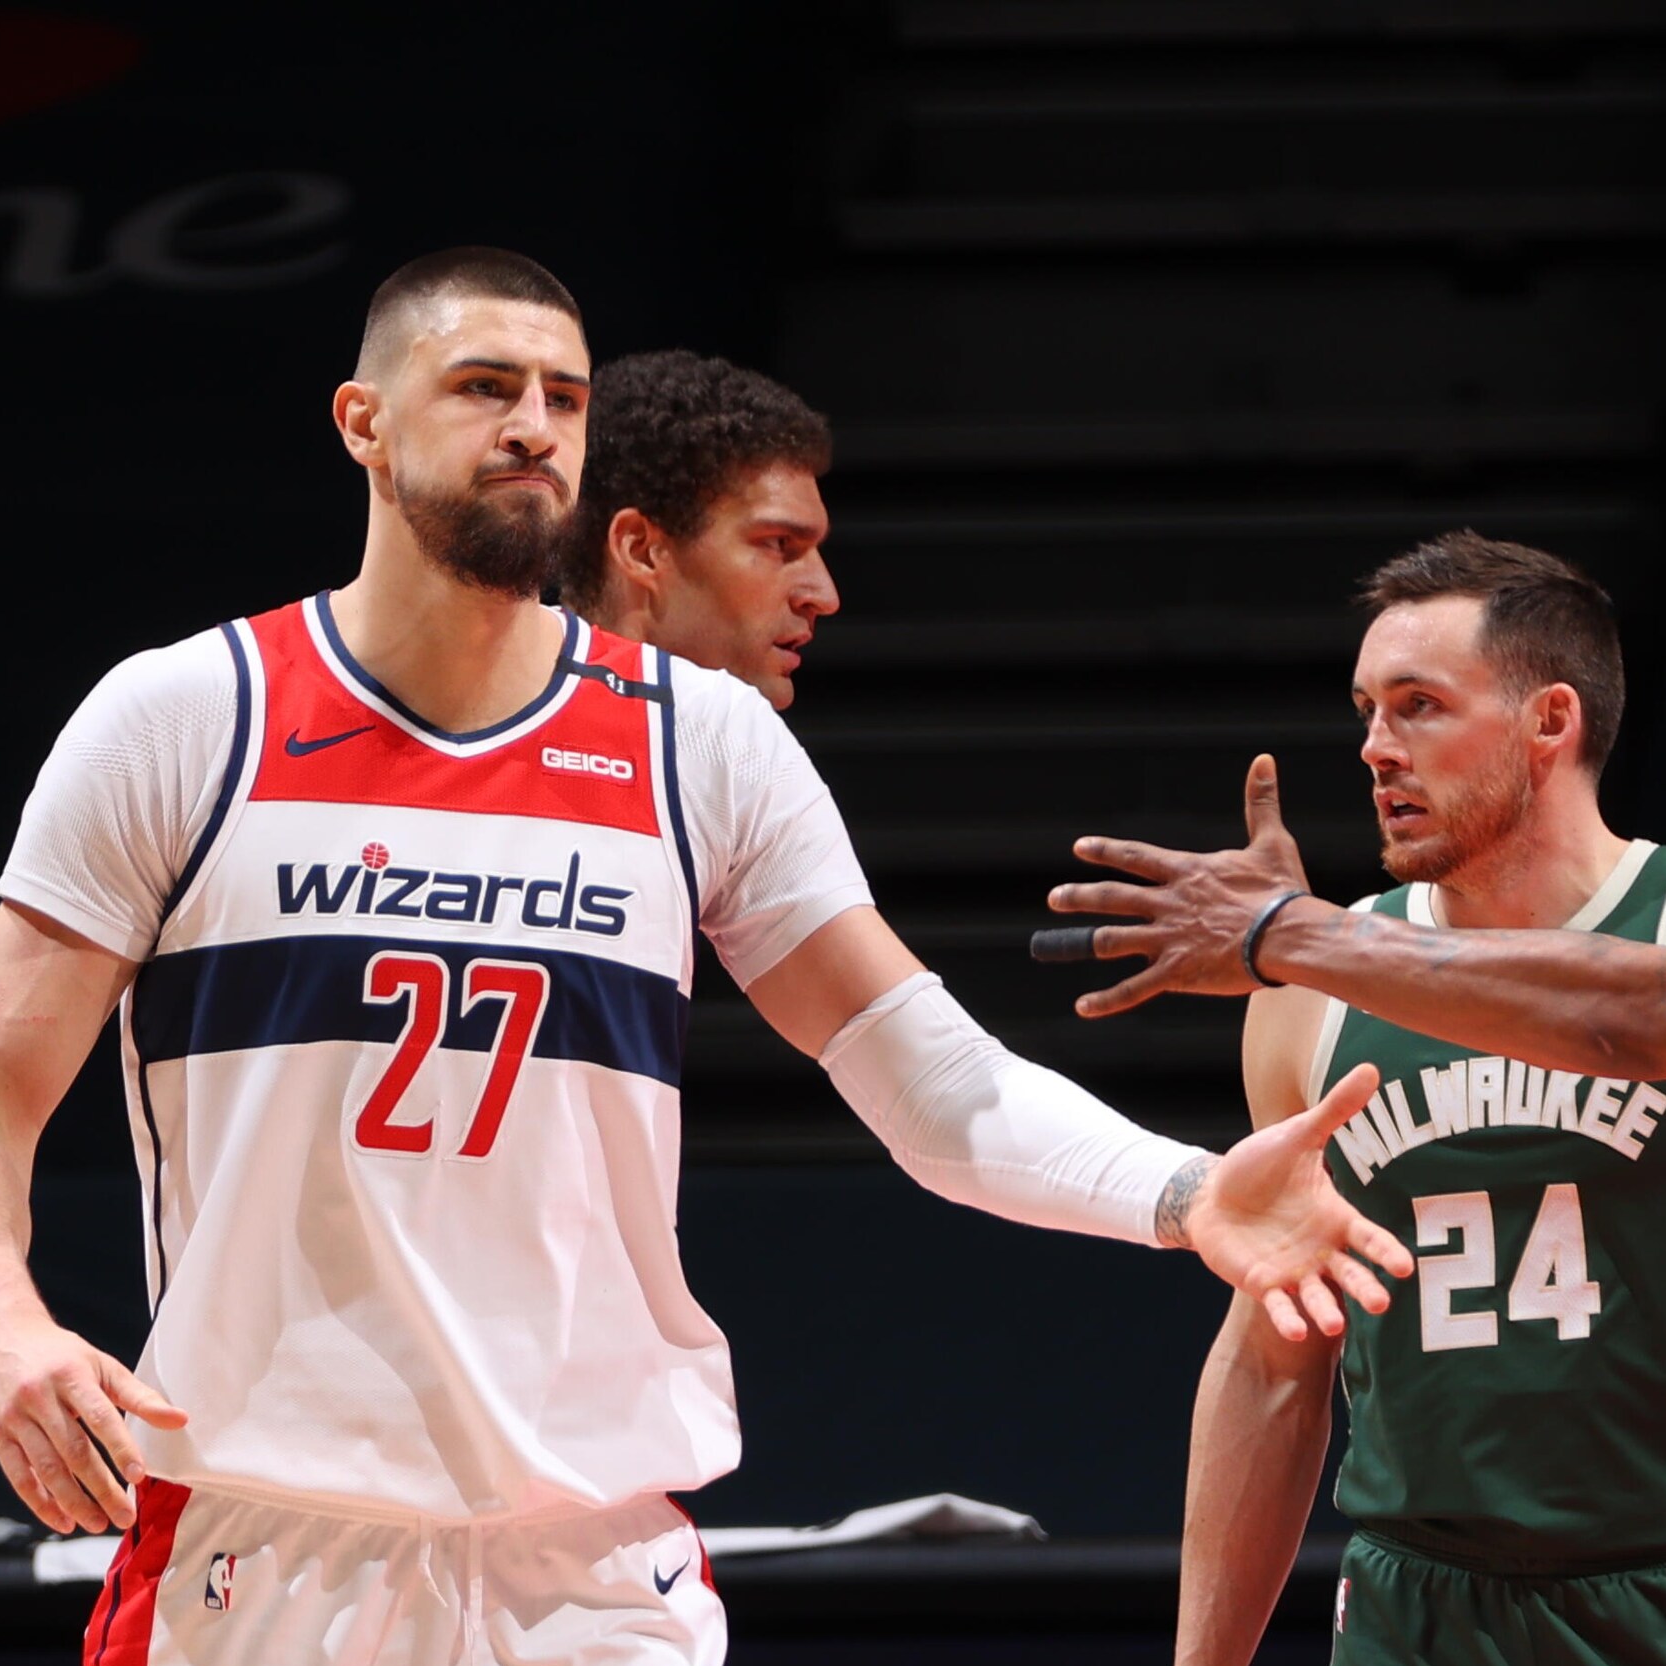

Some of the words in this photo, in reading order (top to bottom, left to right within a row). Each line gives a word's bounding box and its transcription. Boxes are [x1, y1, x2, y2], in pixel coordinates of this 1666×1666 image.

[541, 746, 634, 780] GEICO
[275, 842, 636, 938] wizards
[352, 950, 551, 1162] 27
[1411, 1182, 1602, 1353] 24
